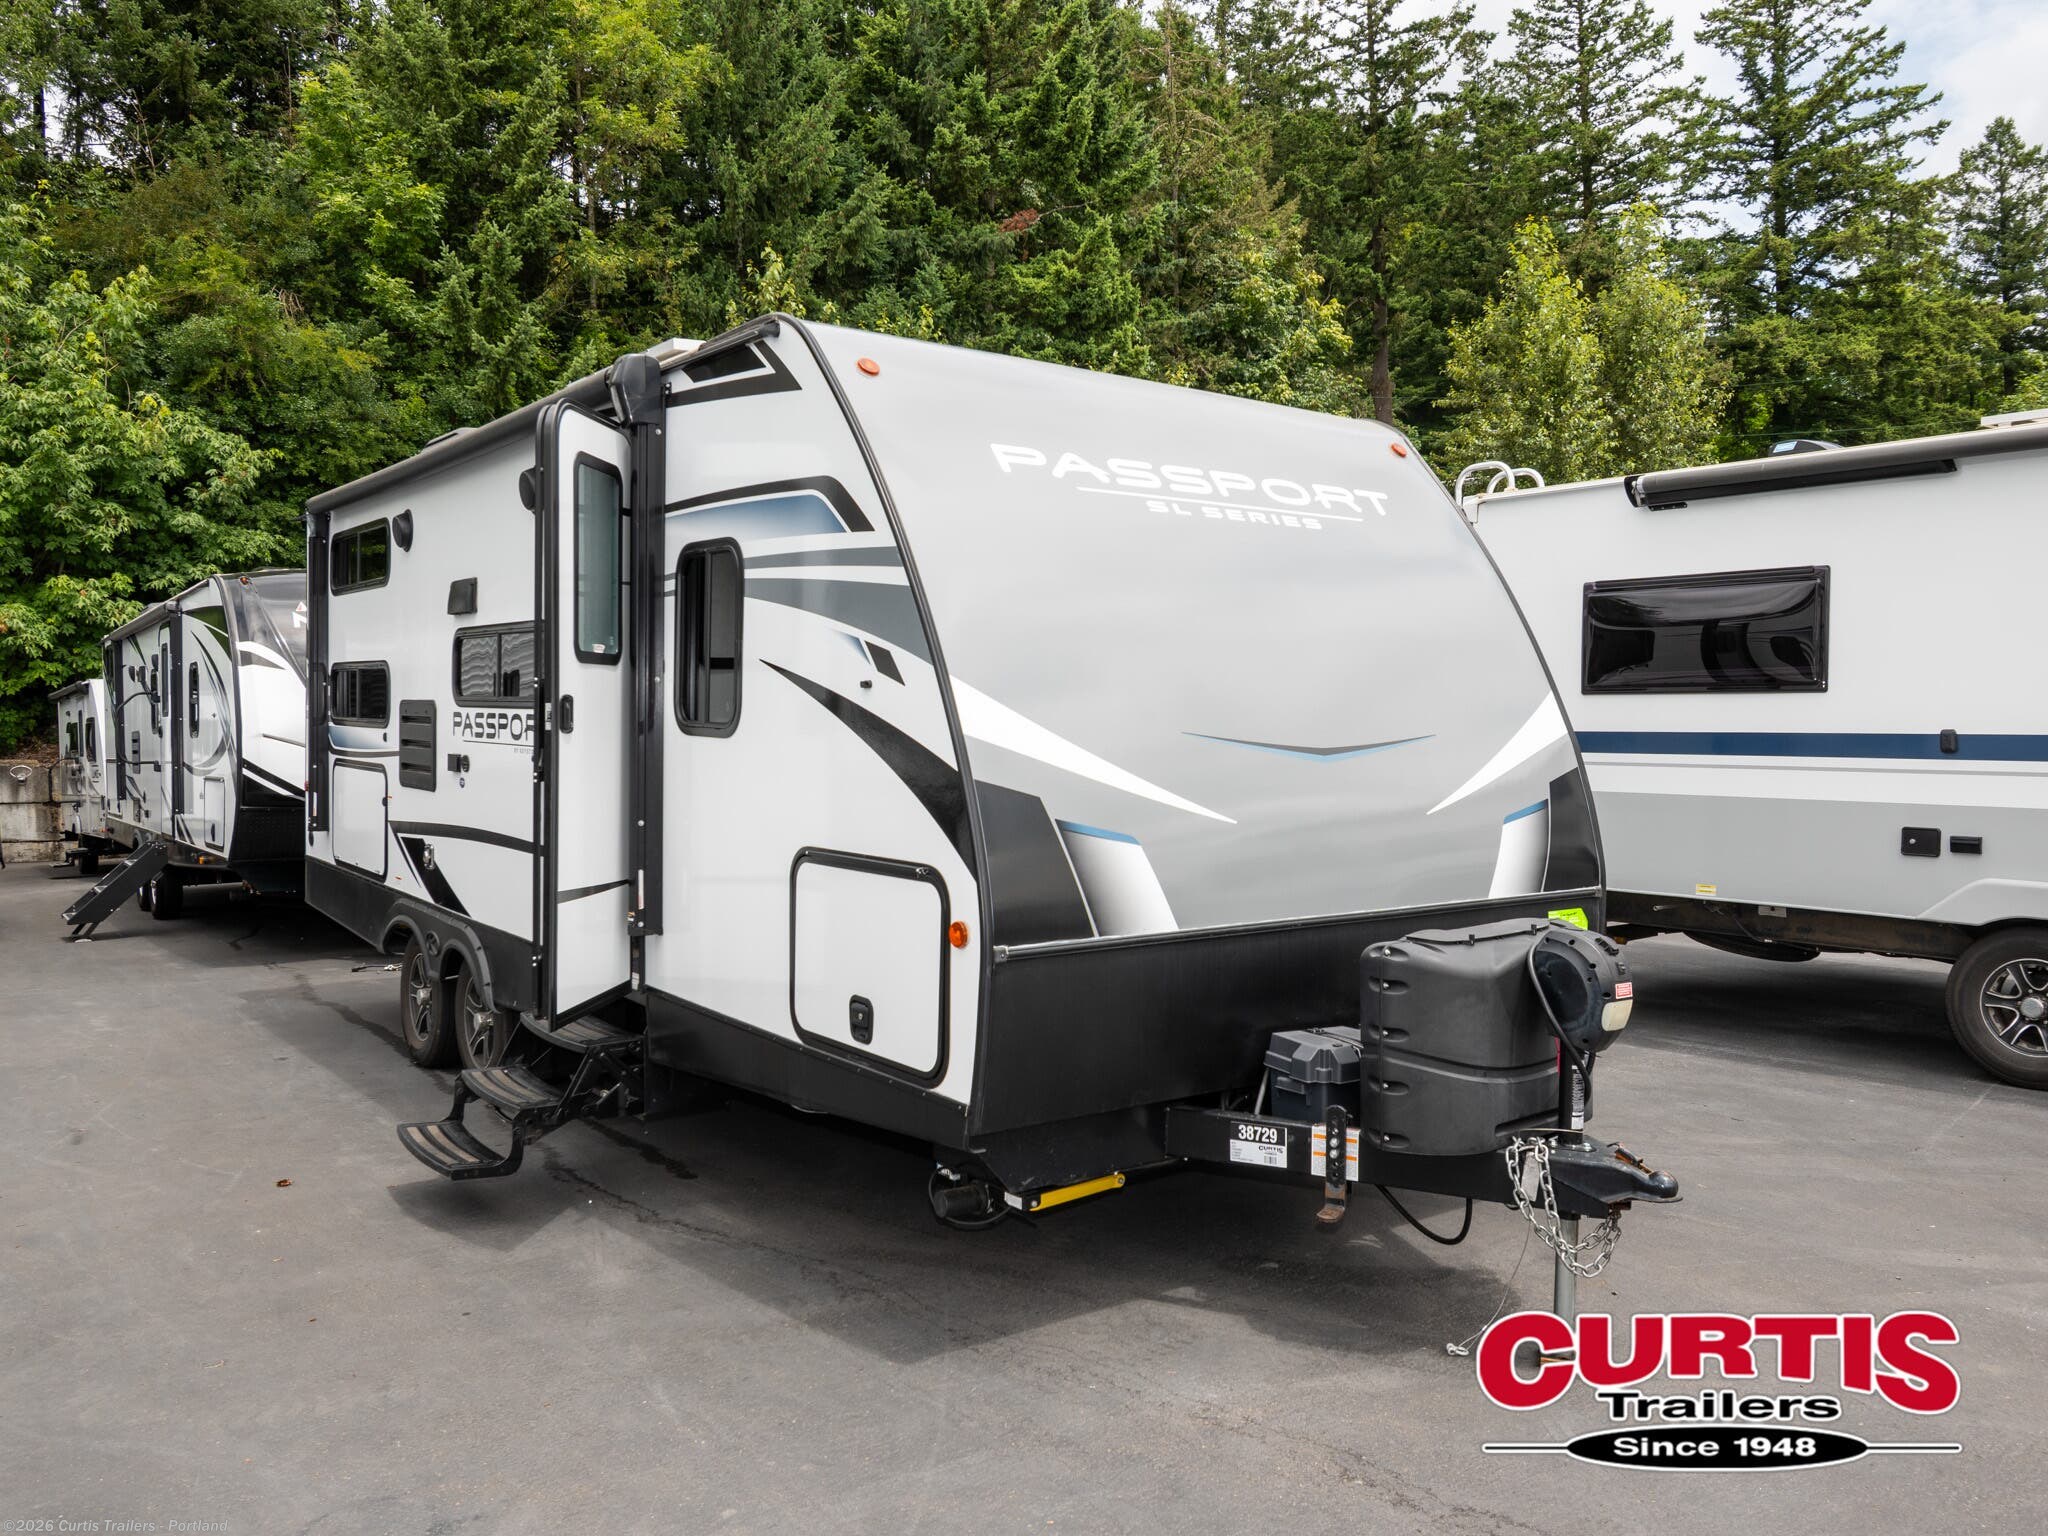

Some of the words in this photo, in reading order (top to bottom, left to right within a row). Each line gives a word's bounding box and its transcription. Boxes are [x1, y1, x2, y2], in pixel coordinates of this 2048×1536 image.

[990, 443, 1388, 516] PASSPORT
[1146, 500, 1192, 516] SL
[1201, 506, 1322, 530] SERIES
[453, 712, 534, 741] PASSPOR
[1238, 1124, 1277, 1143] 38729
